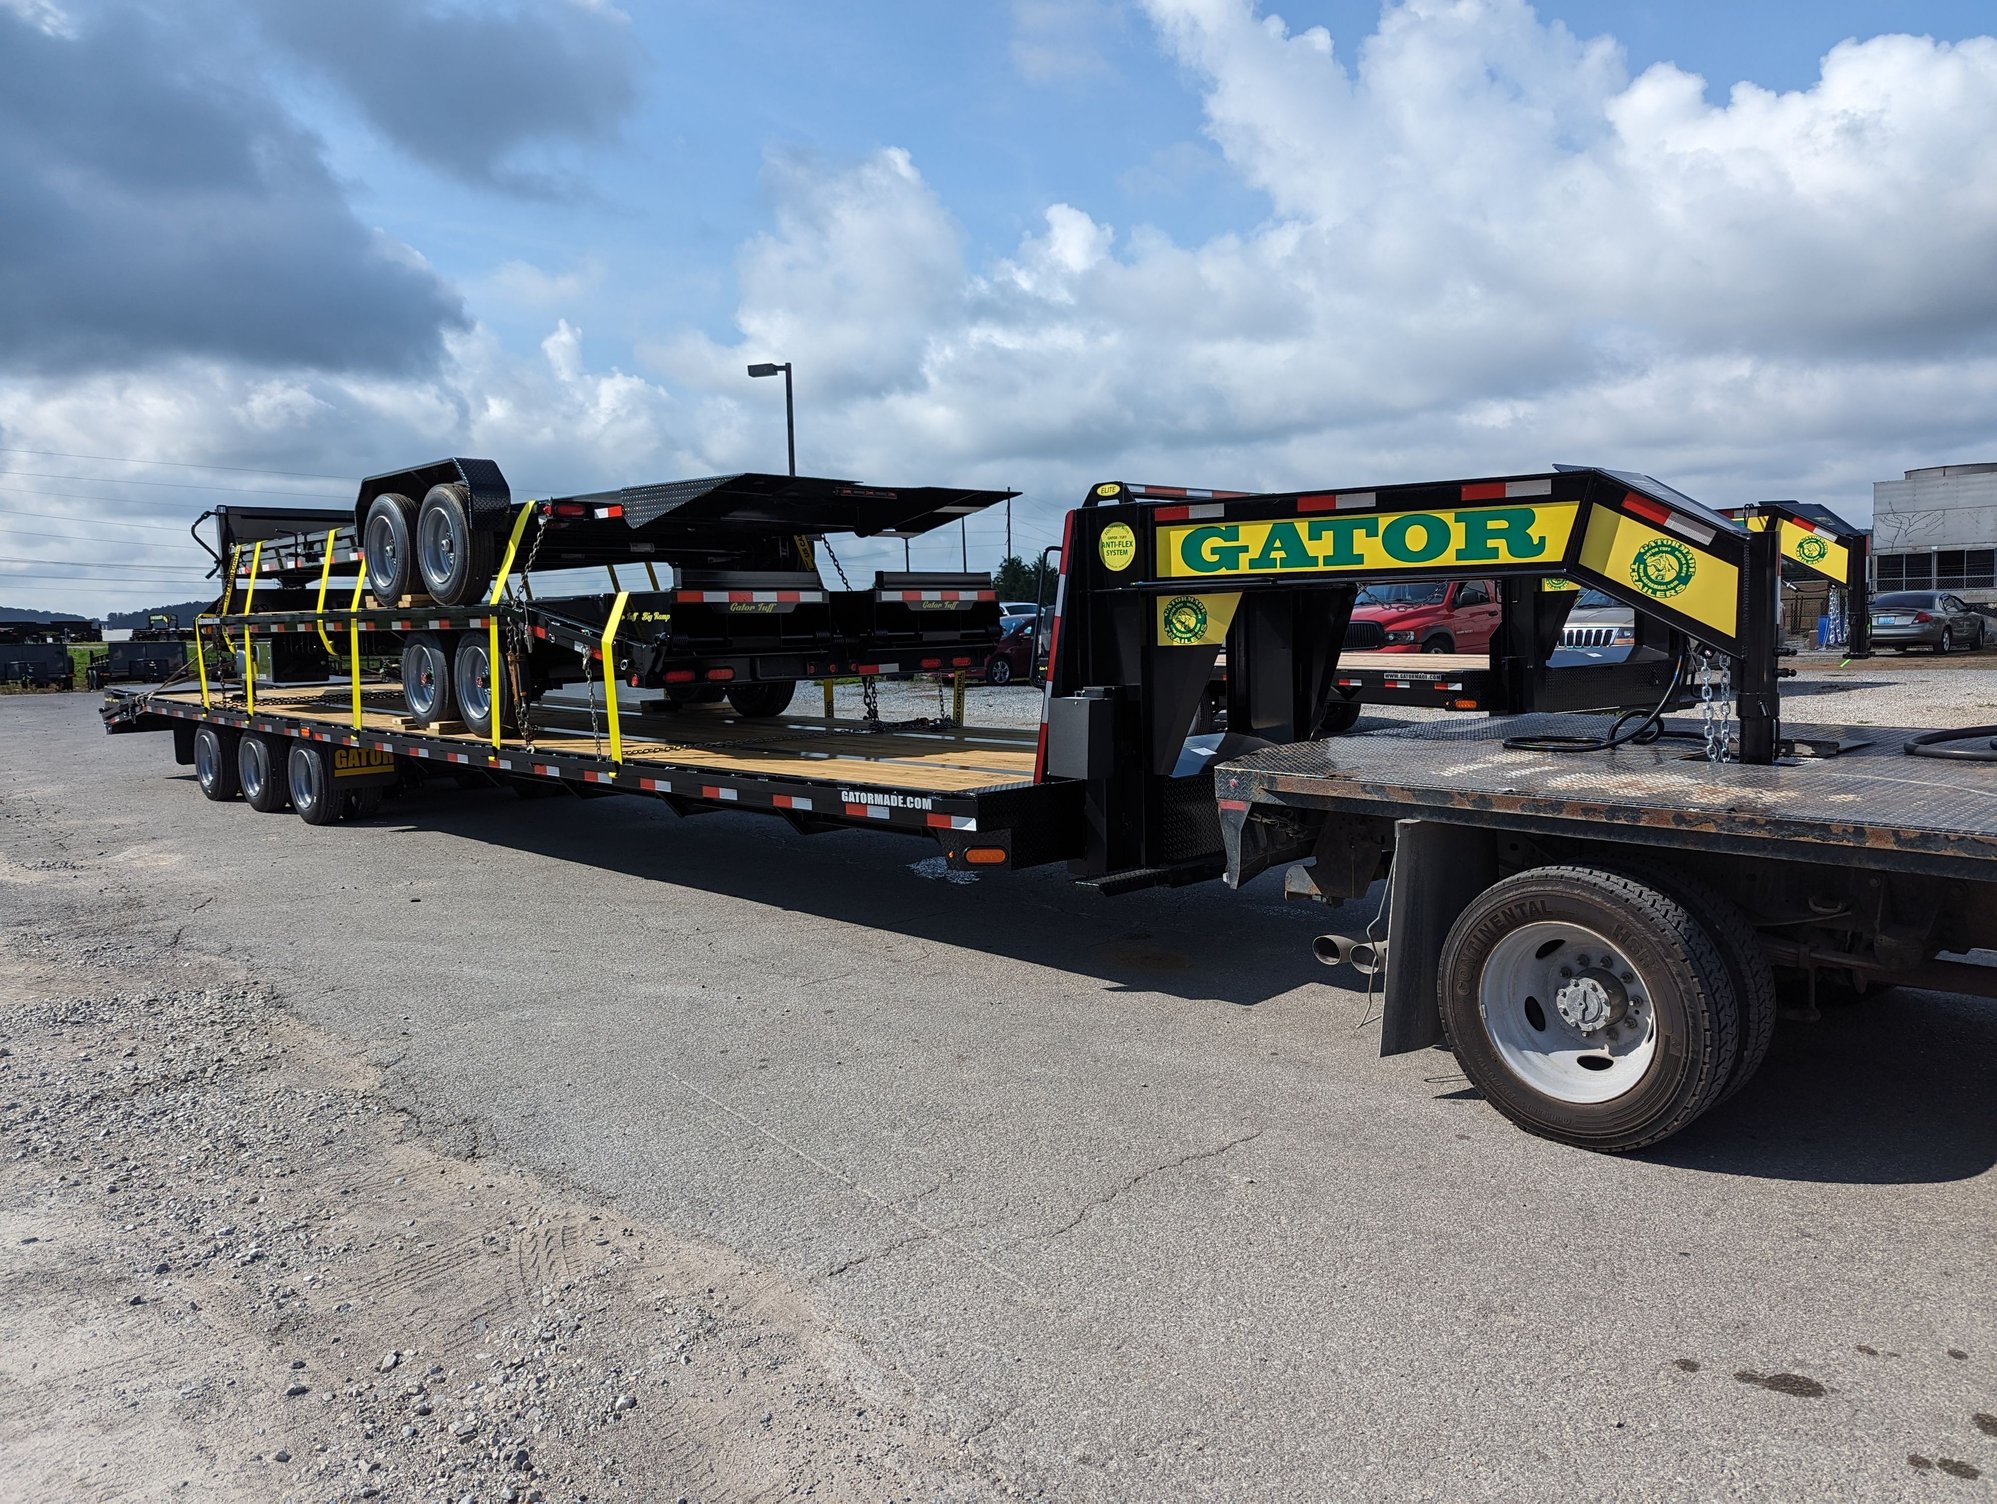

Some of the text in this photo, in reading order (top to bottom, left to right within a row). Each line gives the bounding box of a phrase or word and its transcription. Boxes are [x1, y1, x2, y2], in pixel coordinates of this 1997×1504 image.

[1101, 486, 1116, 494] ELITE
[1102, 541, 1133, 549] ANTI-FLEX
[1181, 507, 1546, 573] GATOR
[1639, 538, 1697, 576] GATORMADE
[1629, 562, 1687, 599] TRAILERS
[730, 602, 777, 613] Gator Tuff
[922, 600, 960, 611] Gator Tuff
[1163, 624, 1209, 644] TRAILERS
[334, 748, 395, 769] GATOR
[841, 790, 932, 810] GATORMADE.COM
[1455, 899, 1553, 997] CONTINENTAL
